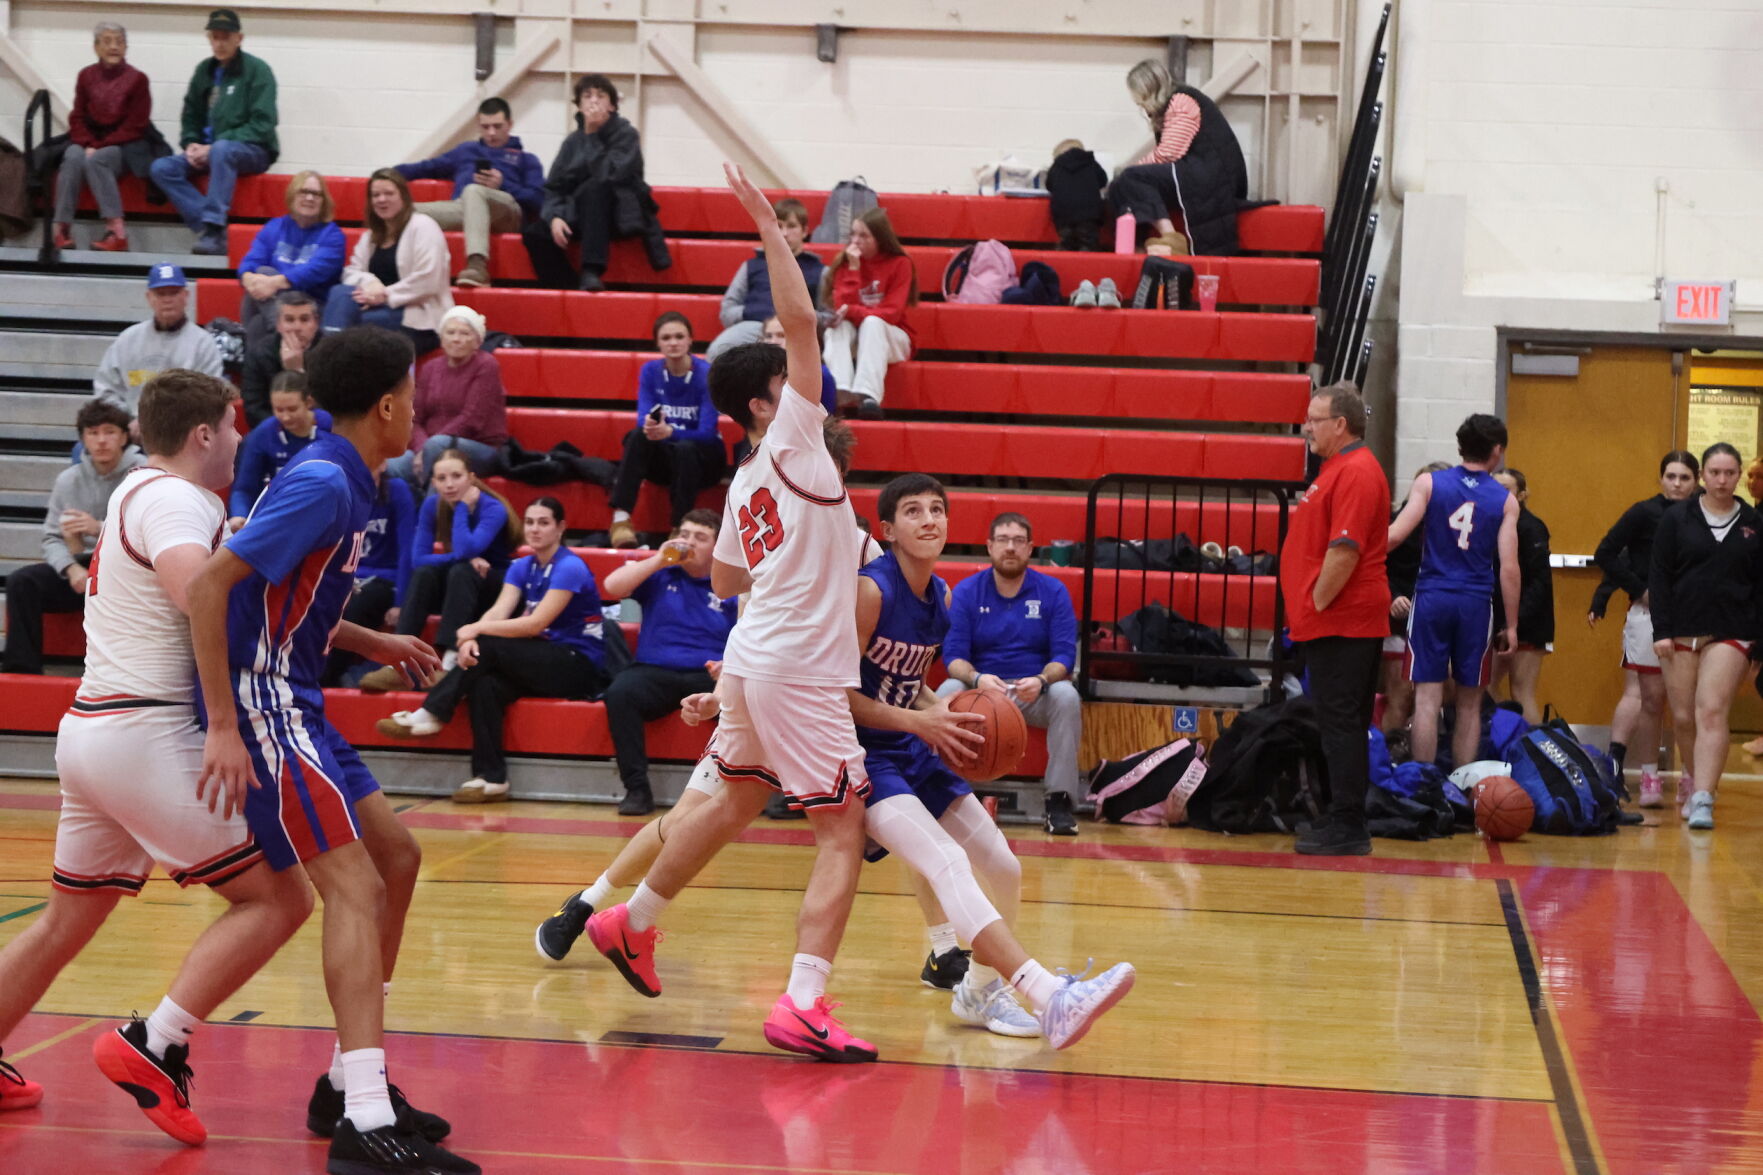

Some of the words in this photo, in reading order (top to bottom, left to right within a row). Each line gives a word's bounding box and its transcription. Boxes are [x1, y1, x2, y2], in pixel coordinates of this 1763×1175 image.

[1676, 285, 1723, 320] EXIT
[661, 404, 699, 420] RURY
[1704, 395, 1731, 404] ROOM
[738, 486, 785, 572] 23
[1448, 501, 1475, 551] 4
